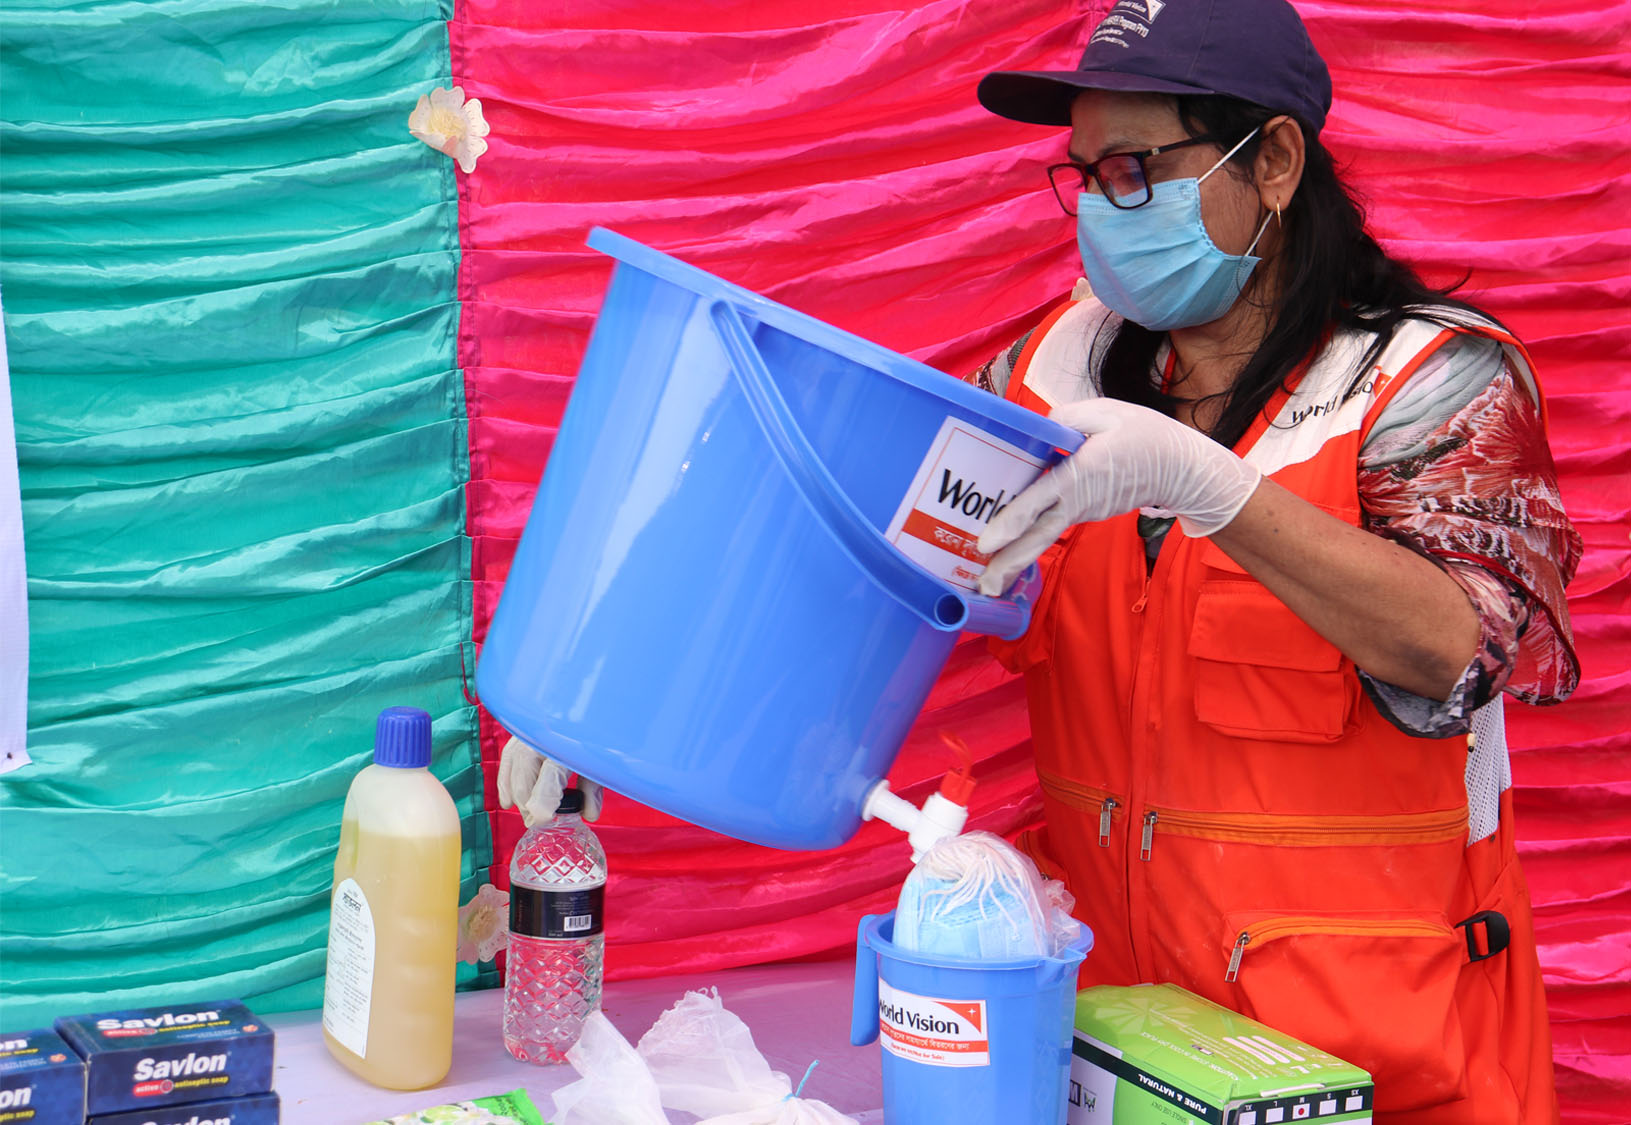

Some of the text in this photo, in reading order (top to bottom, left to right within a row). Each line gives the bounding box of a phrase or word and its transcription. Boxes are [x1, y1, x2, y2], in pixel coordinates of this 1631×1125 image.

[1292, 395, 1338, 423] World
[96, 1010, 219, 1030] Savlon
[906, 1010, 960, 1035] Vision
[134, 1052, 227, 1081] Savlon
[174, 1078, 210, 1088] antiseptic
[211, 1076, 229, 1084] soap
[1138, 1073, 1207, 1114] PURE & NATURAL
